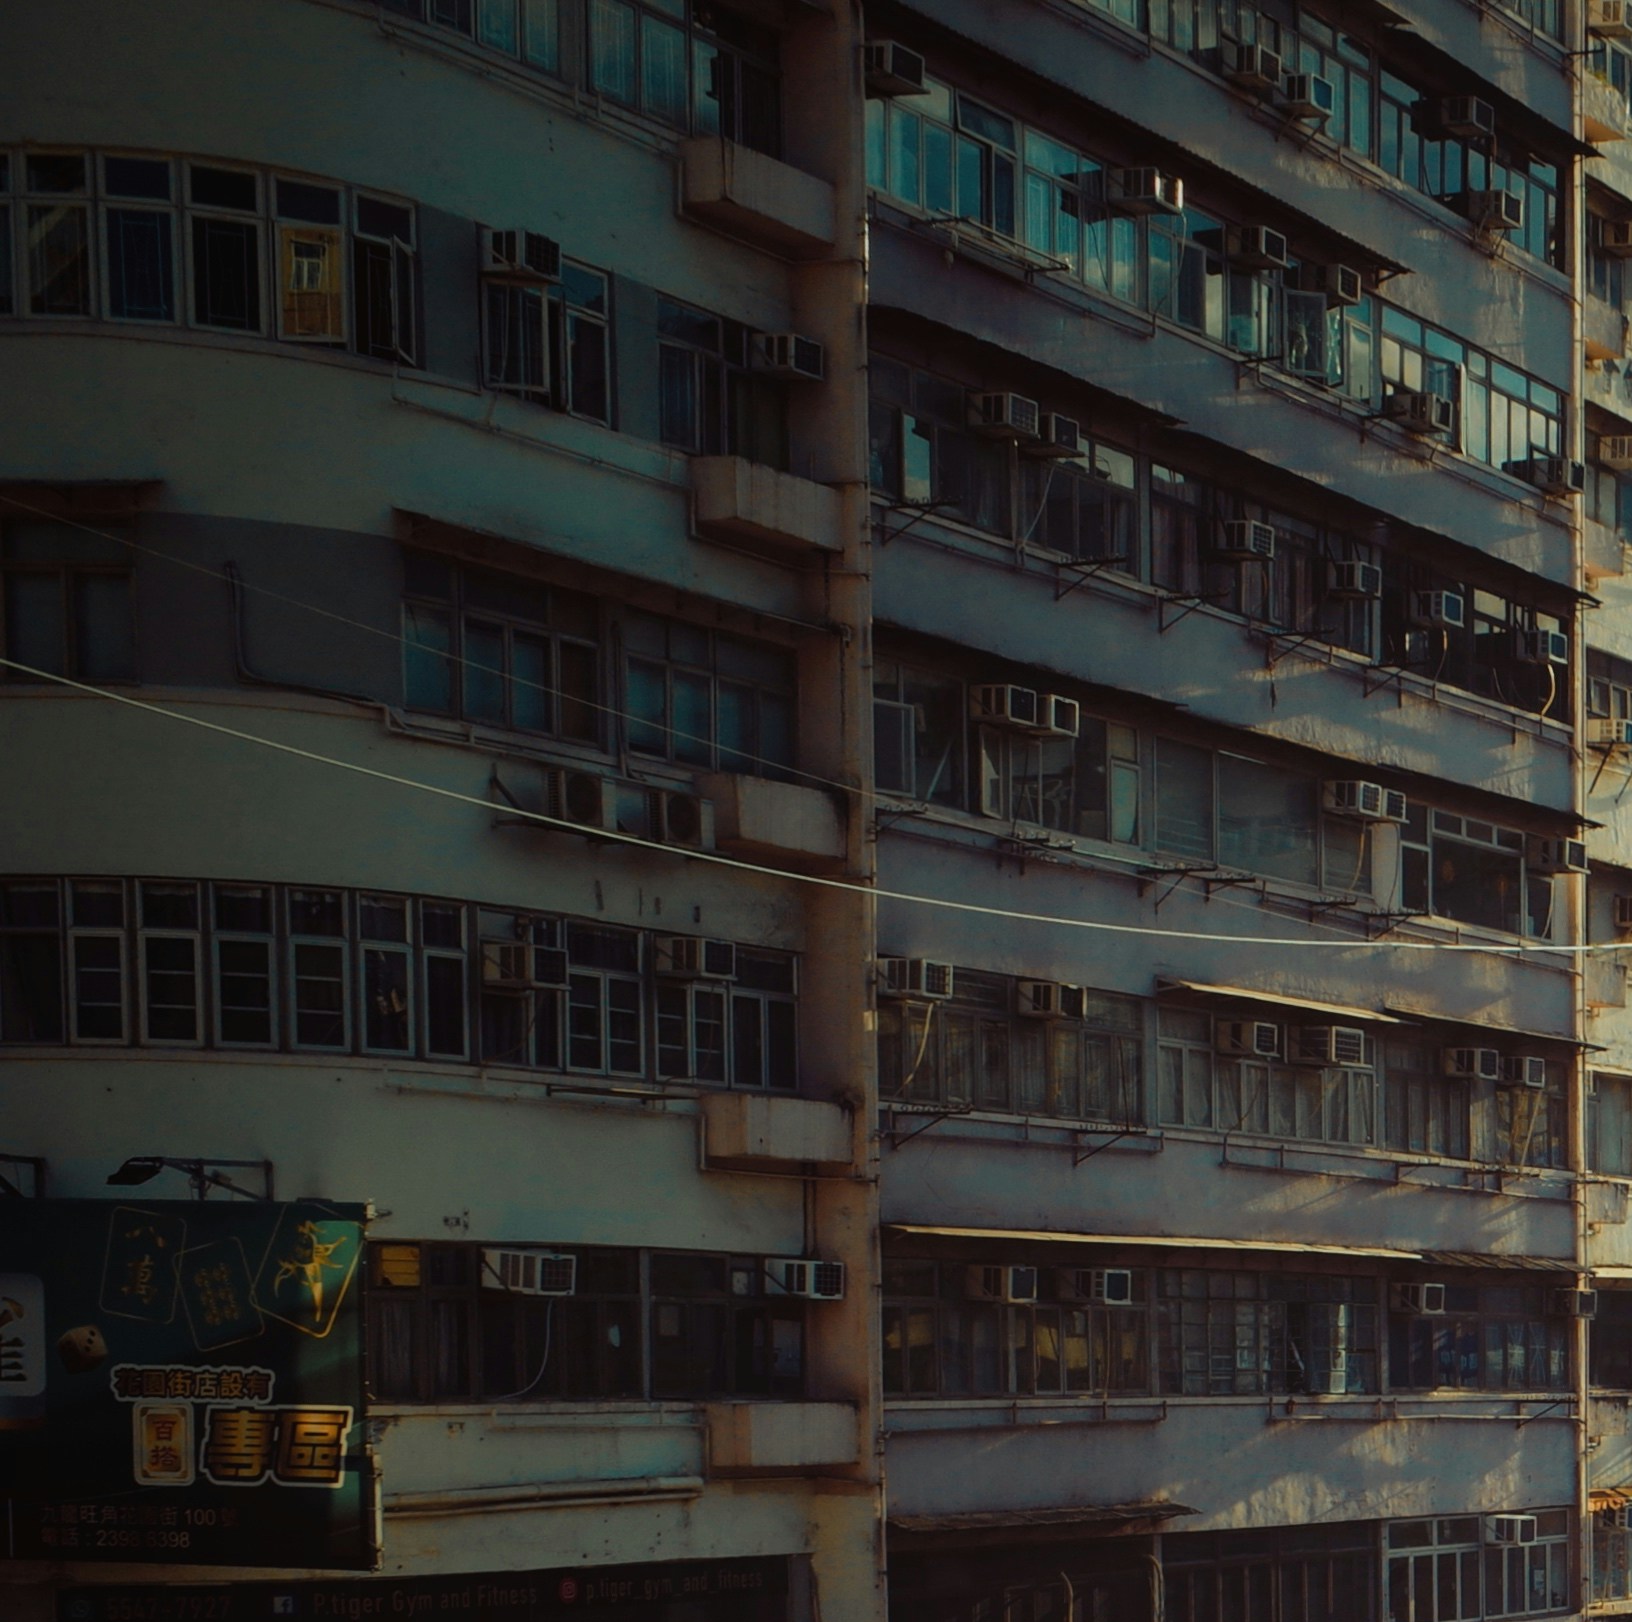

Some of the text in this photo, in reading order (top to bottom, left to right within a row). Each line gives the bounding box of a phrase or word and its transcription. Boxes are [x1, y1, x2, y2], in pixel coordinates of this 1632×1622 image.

[115, 1367, 271, 1398] 花園街店設有
[207, 1409, 347, 1483] 專區
[184, 1508, 217, 1526] 100
[391, 1590, 432, 1616] Gym
[440, 1590, 470, 1609] and
[477, 1585, 537, 1606] Fitness
